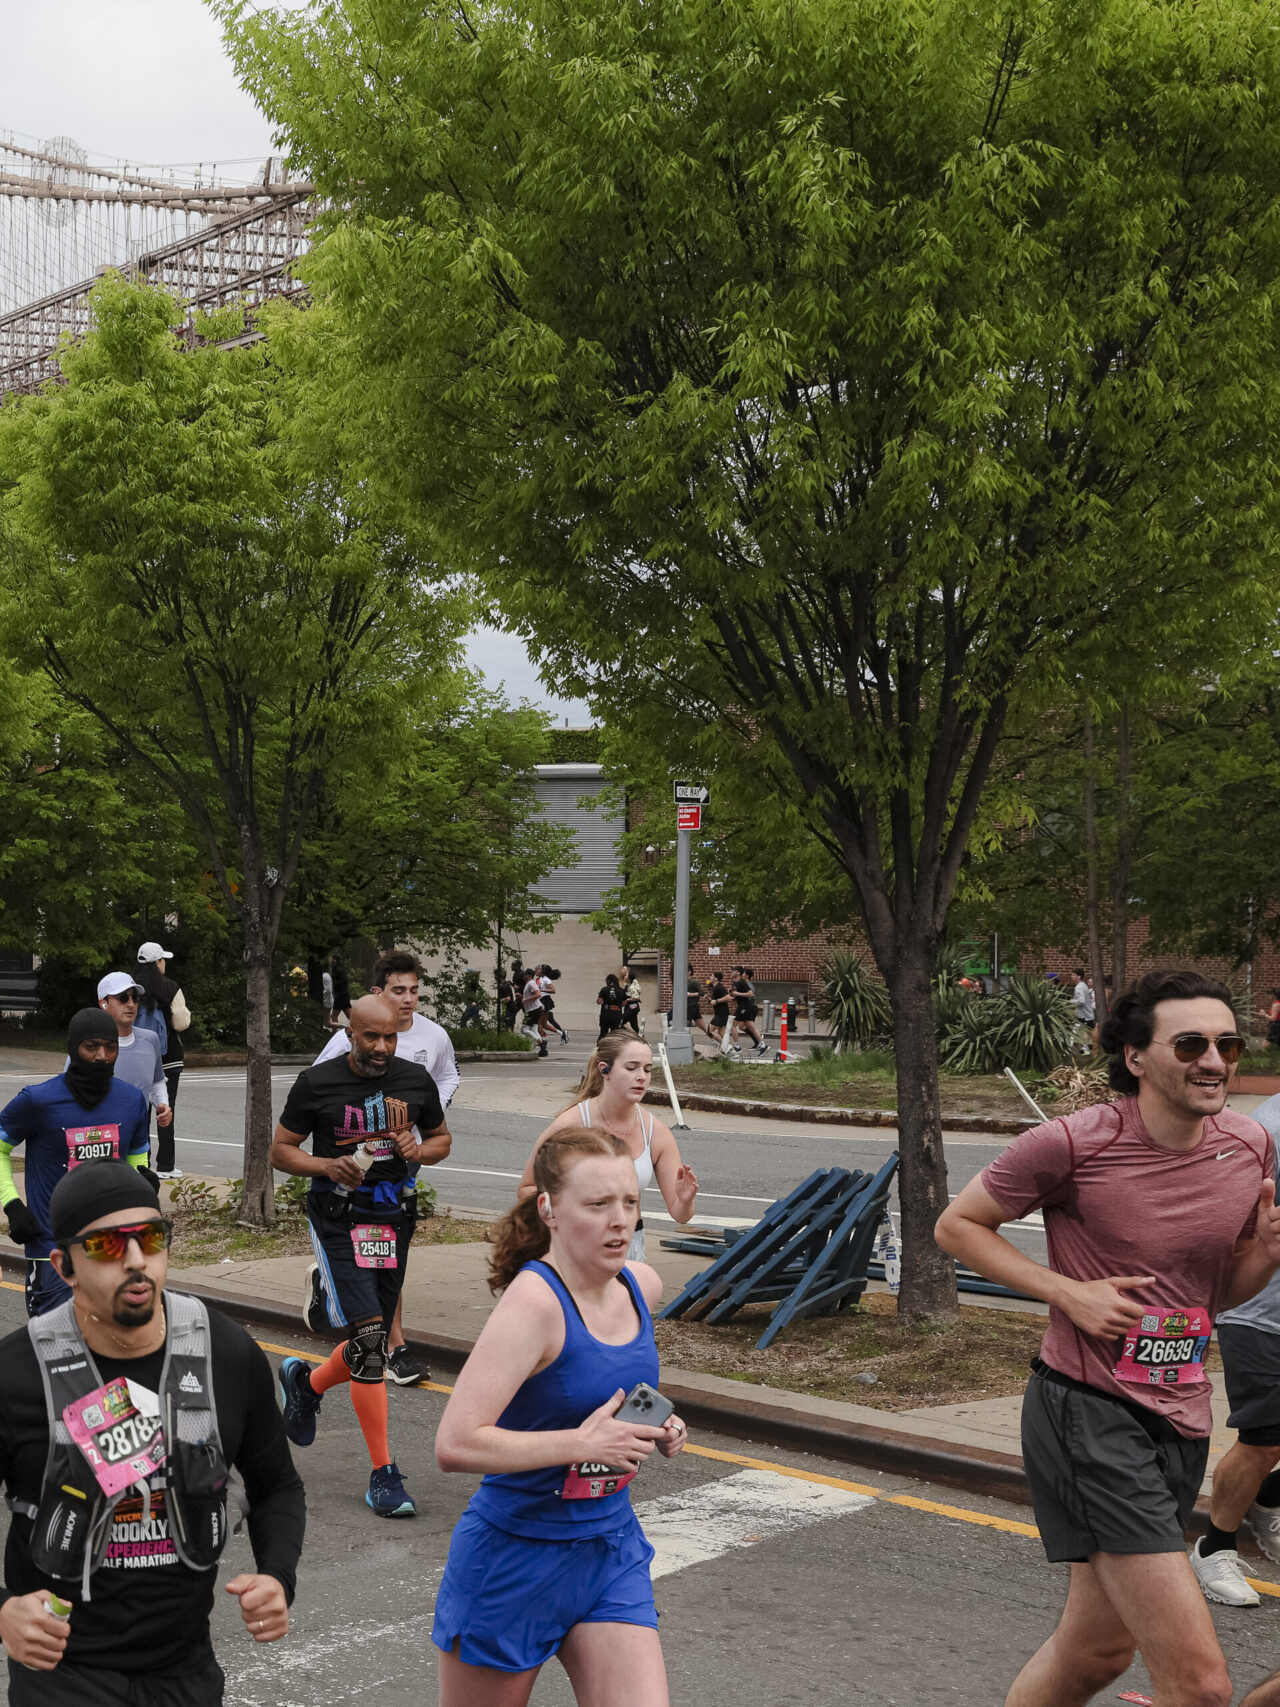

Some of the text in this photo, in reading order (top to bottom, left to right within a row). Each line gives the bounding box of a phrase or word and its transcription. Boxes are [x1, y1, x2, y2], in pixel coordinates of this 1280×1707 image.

[678, 786, 700, 797] ONE WAY
[78, 1142, 112, 1160] 20917
[361, 1241, 389, 1256] 25418
[1124, 1342, 1135, 1357] 2
[1136, 1338, 1194, 1363] 26639
[87, 1448, 102, 1465] 2
[108, 1518, 172, 1543] ROOKLY
[123, 1553, 180, 1569] MARATHON
